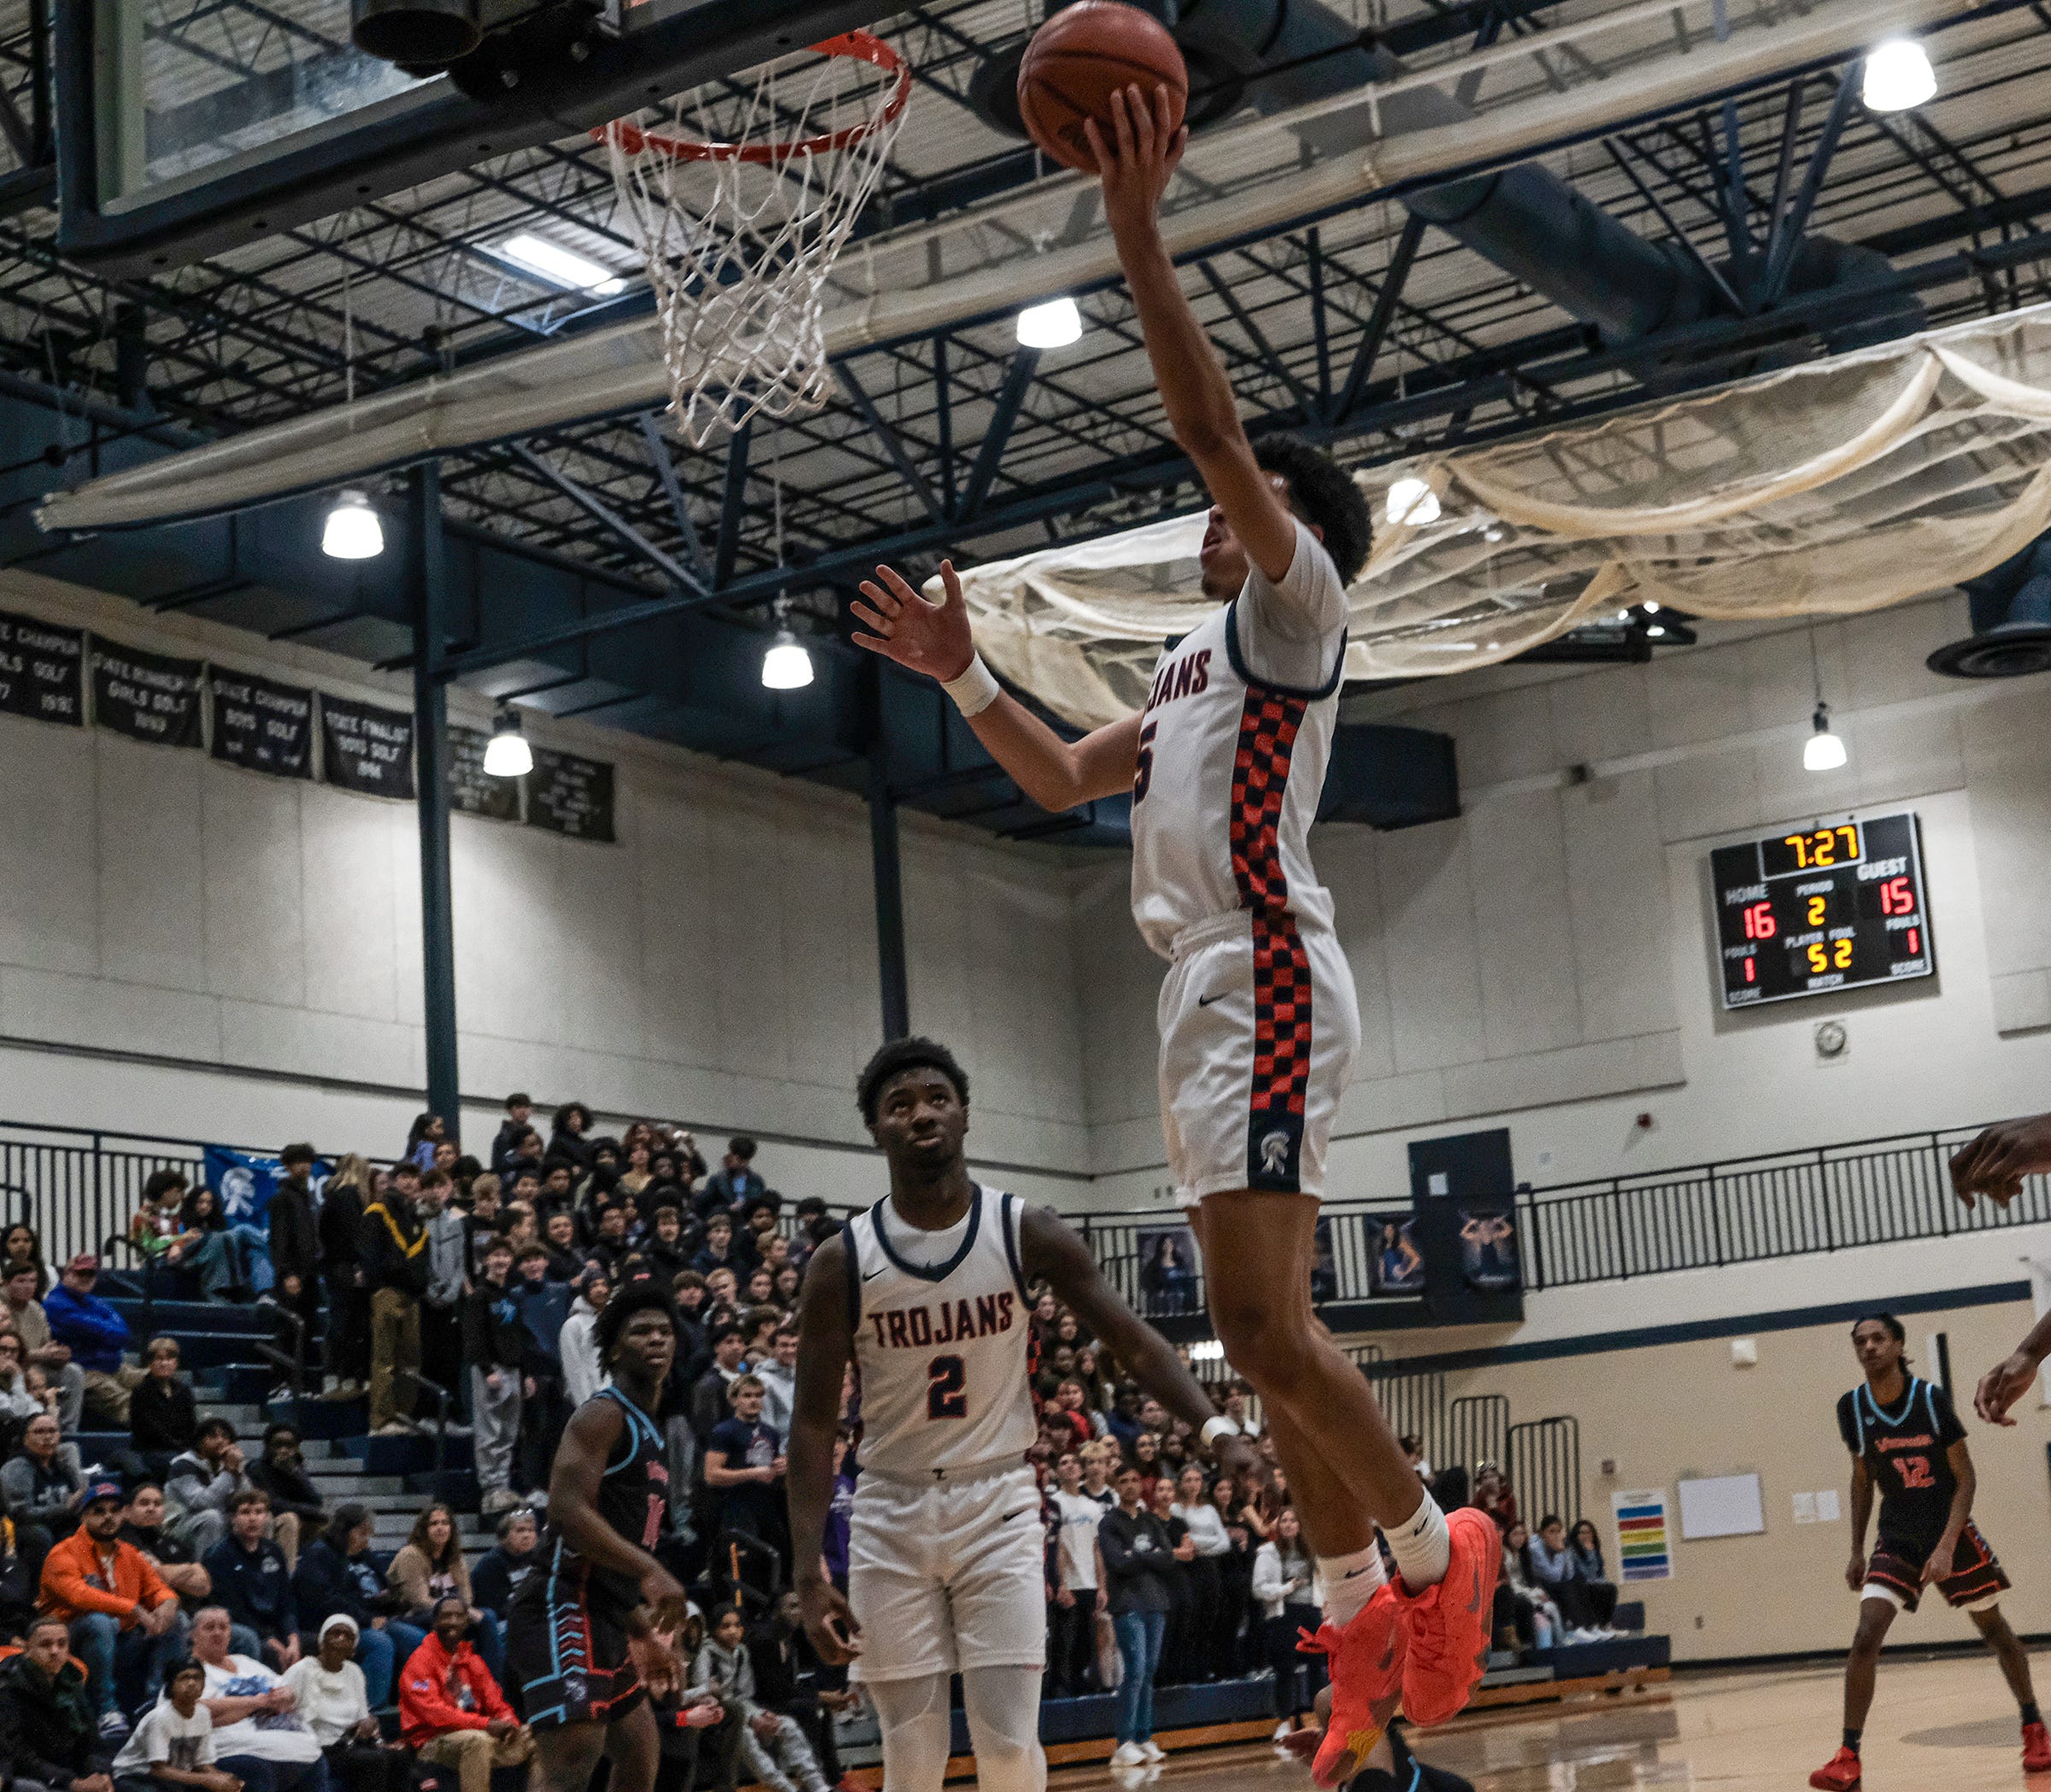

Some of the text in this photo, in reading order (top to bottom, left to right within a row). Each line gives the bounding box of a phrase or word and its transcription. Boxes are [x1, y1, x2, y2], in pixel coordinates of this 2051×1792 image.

[1146, 647, 1213, 714] JANS
[1784, 825, 1859, 868] 7:27
[1856, 856, 1908, 882] GUEST
[1725, 883, 1769, 906] HOME
[1795, 879, 1835, 898] PERIOD
[1880, 876, 1914, 915] 15
[1743, 902, 1777, 939] 16
[1807, 896, 1826, 926] 2
[1783, 931, 1825, 949] PLAYER
[1907, 927, 1919, 955] 1
[1744, 955, 1756, 983] 1
[867, 1291, 1014, 1349] TROJANS
[926, 1353, 967, 1421] 2
